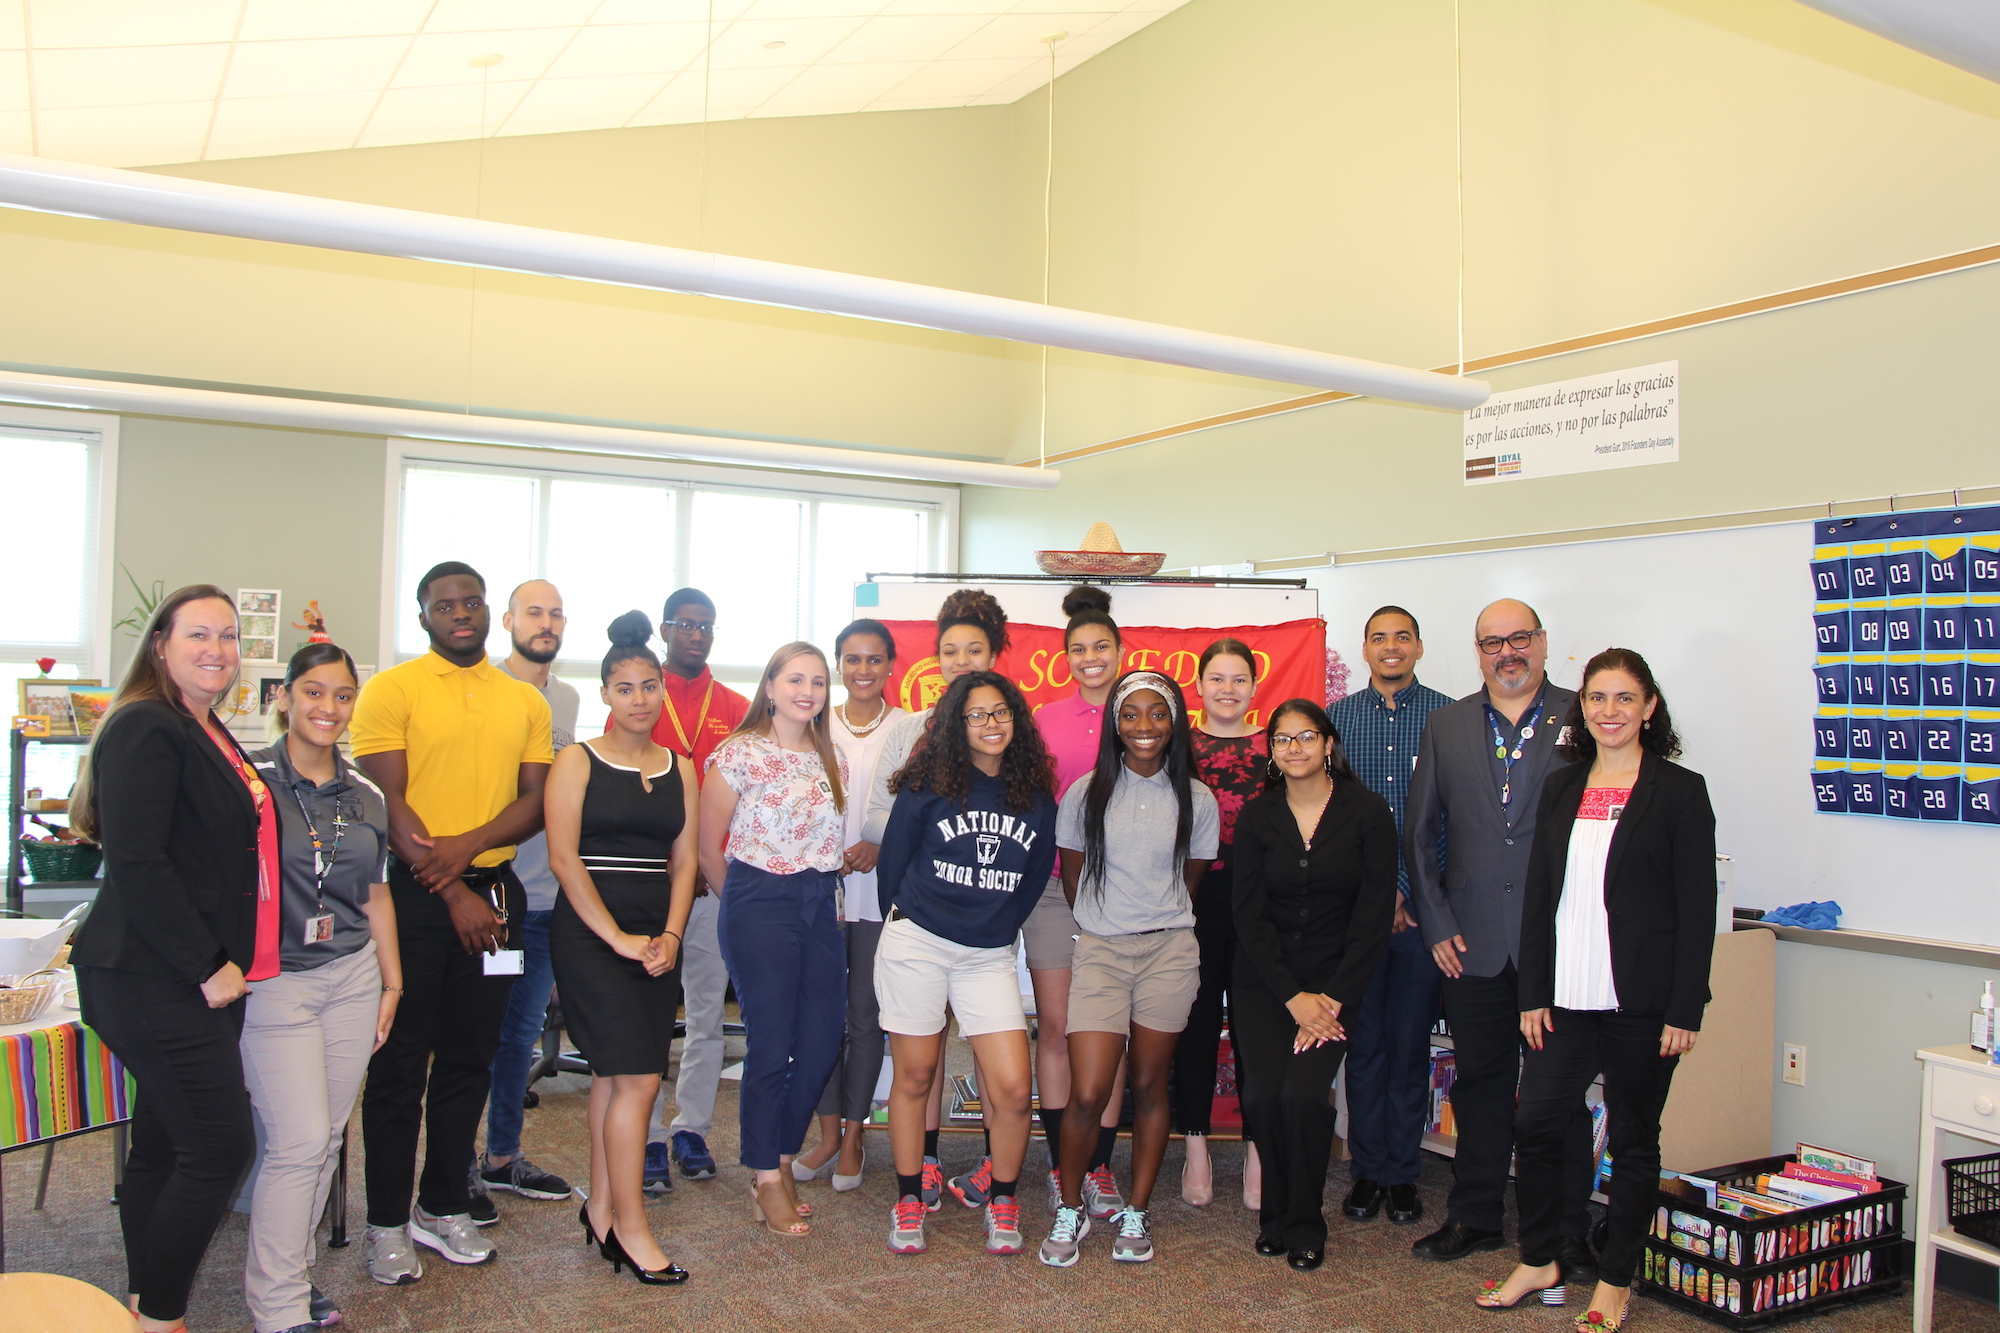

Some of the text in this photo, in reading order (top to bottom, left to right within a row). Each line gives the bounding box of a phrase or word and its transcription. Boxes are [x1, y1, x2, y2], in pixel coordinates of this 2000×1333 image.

[1483, 400, 1512, 421] mejor
[1513, 396, 1551, 413] manera
[1554, 389, 1566, 406] de
[1568, 385, 1614, 408] expresar
[1616, 379, 1631, 396] las
[1633, 373, 1674, 399] gracias
[1465, 398, 1674, 450] es por las acciones, y no por las palabras”
[1648, 437, 1656, 450] Day
[1656, 435, 1675, 448] Assembly
[1497, 452, 1522, 463] LOYAL
[1854, 567, 1875, 586] 02
[1890, 564, 1910, 583] 03
[1931, 562, 1954, 581] 04
[1975, 560, 1998, 579] 05
[1818, 572, 1837, 590] 01
[1818, 625, 1837, 643] 07
[1862, 622, 1878, 641] 08
[1890, 620, 1910, 640] 09
[1933, 620, 1954, 638] 10
[1974, 618, 1993, 637] 11
[1819, 678, 1836, 694] 13
[1855, 677, 1873, 695] 14
[1890, 677, 1909, 695] 15
[1930, 677, 1952, 695] 16
[1974, 677, 1995, 697] 17
[1818, 730, 1836, 747] 19
[1852, 729, 1872, 748] 20
[1888, 731, 1906, 749] 21
[1928, 731, 1950, 749] 22
[1970, 733, 1993, 752] 23
[1816, 784, 1837, 802] 25
[1853, 784, 1873, 802] 26
[1888, 789, 1905, 808] 27
[1923, 790, 1946, 808] 28
[1970, 792, 1990, 811] 29
[937, 811, 1037, 852] NATIONAL
[1794, 1168, 1809, 1178] The
